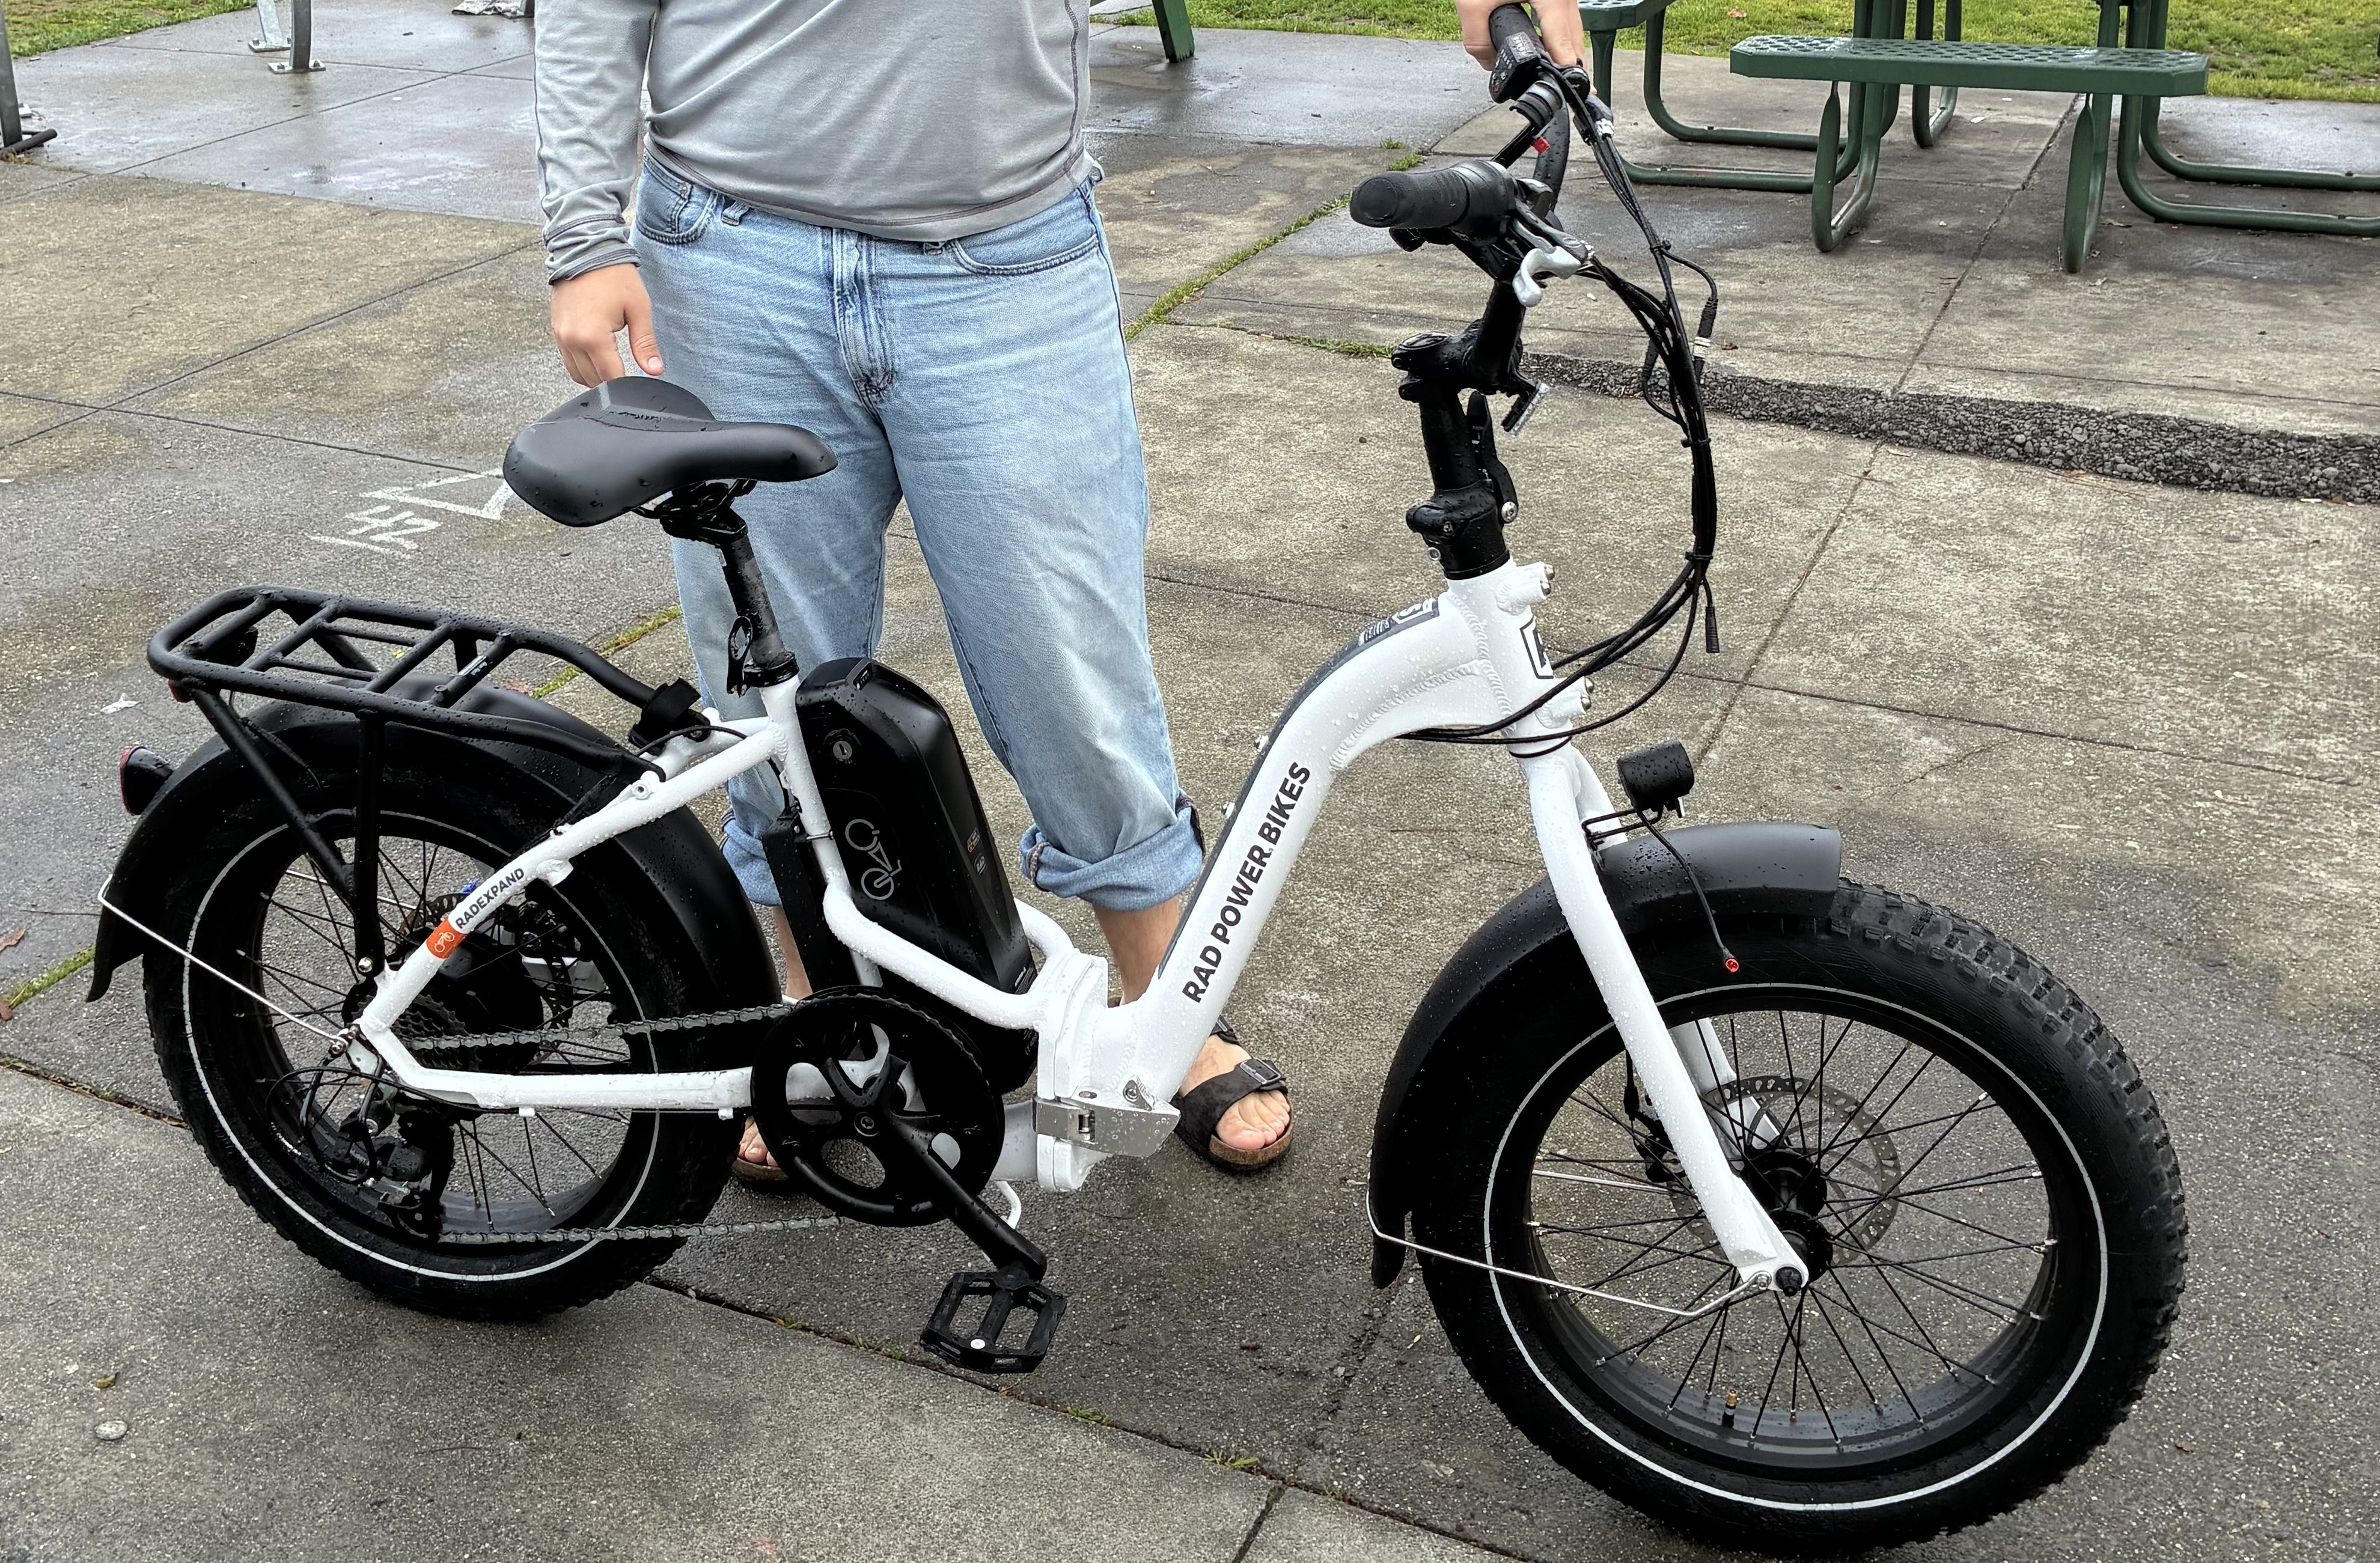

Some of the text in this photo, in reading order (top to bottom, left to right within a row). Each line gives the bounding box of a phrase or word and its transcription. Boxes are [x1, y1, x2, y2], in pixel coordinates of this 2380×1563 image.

[455, 868, 525, 929] RADEXPAND
[1182, 761, 1311, 1003] RAD POWER BIKES
